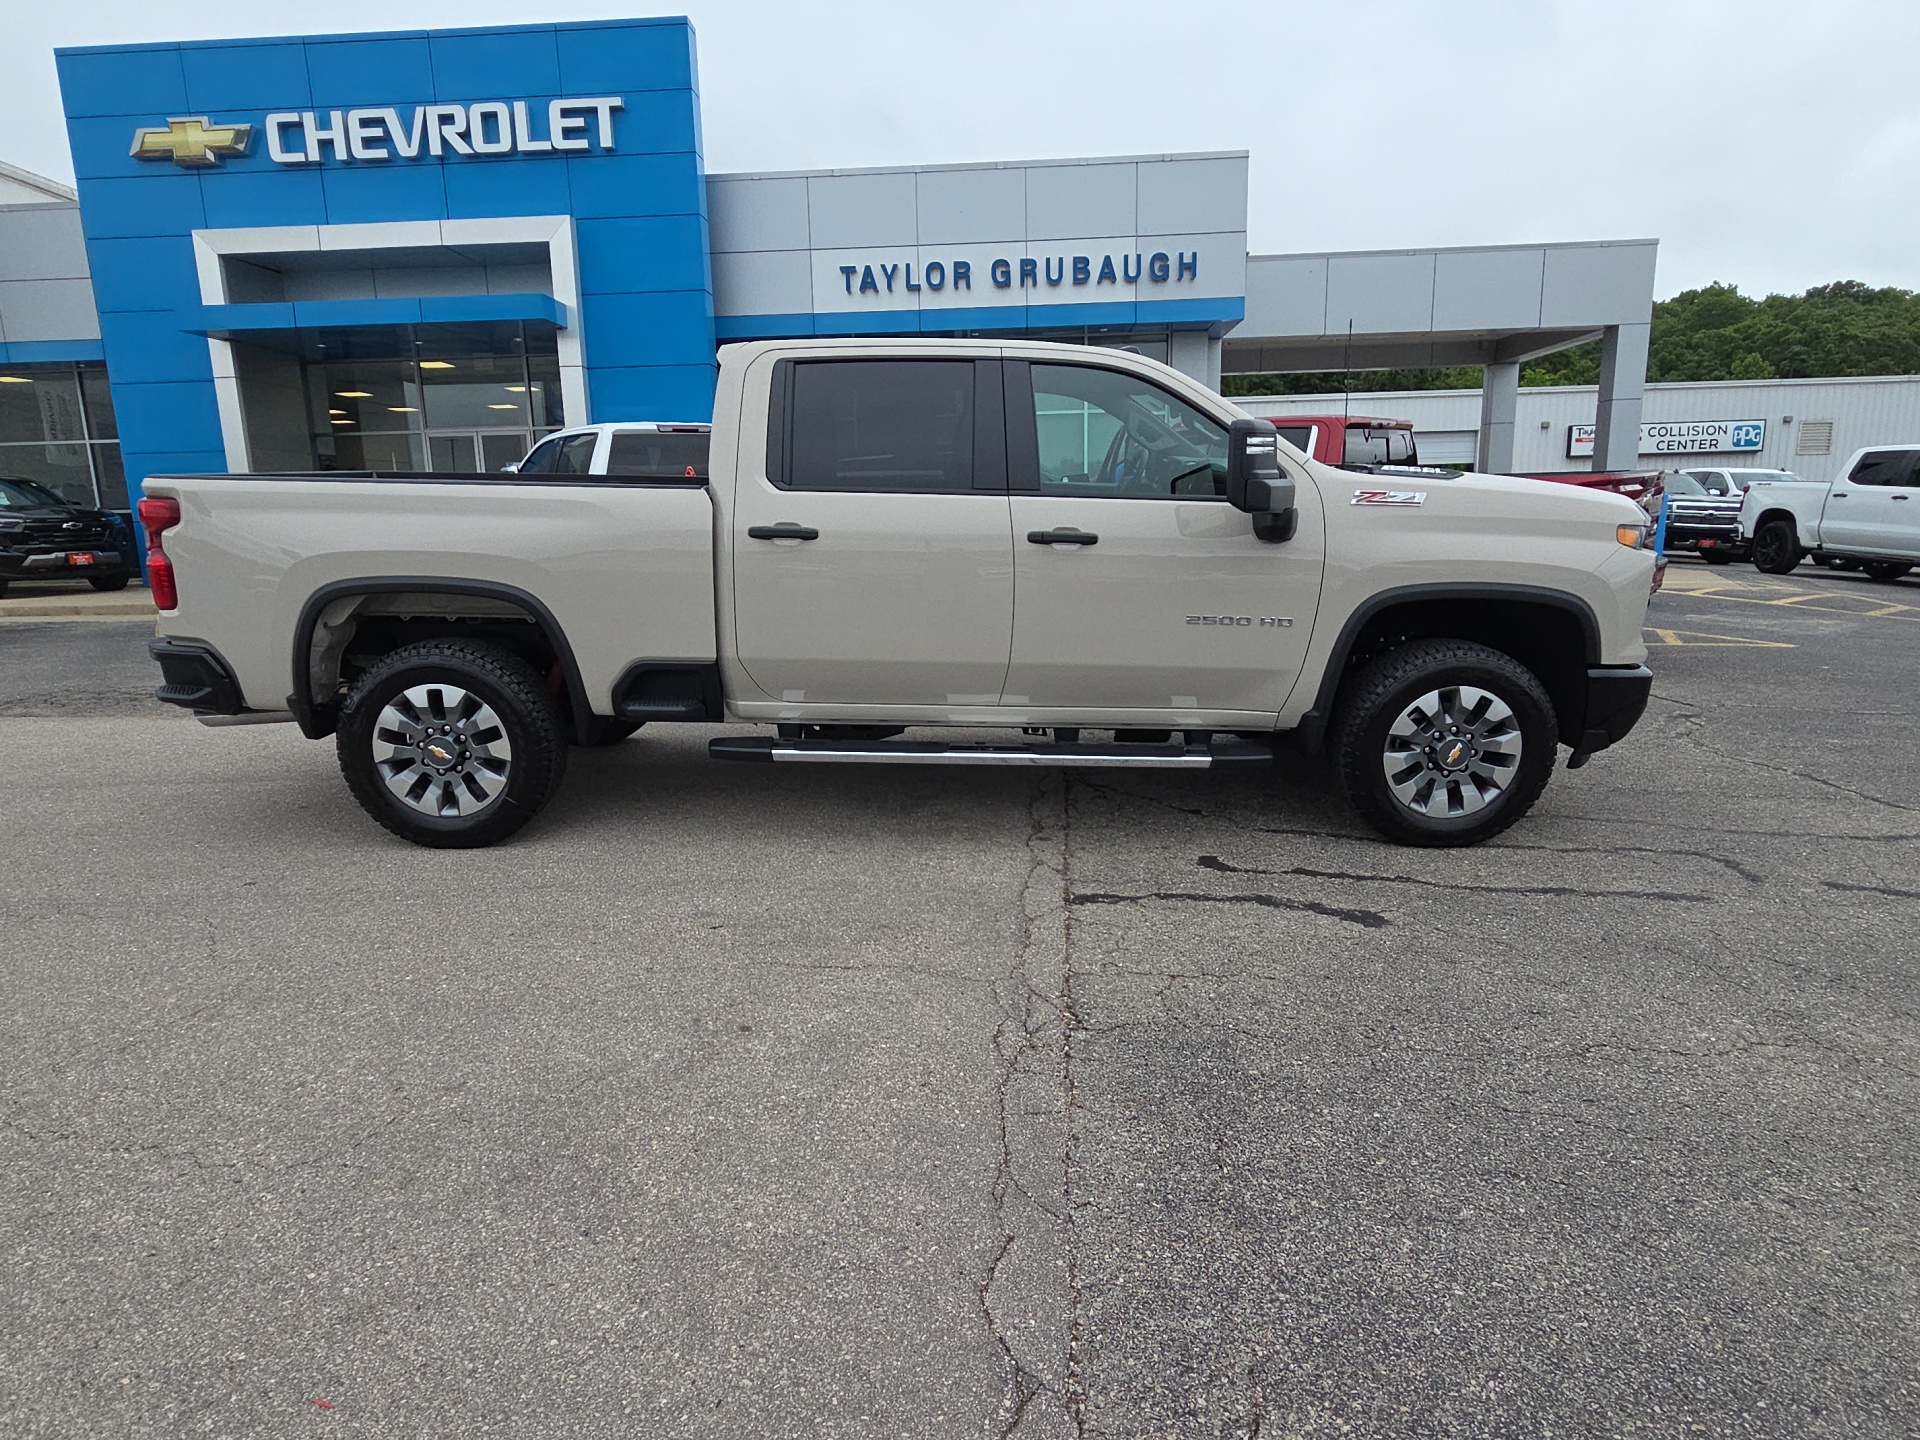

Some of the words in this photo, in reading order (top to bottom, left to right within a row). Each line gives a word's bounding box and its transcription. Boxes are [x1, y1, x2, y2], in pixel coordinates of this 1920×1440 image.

[265, 96, 624, 164] CHEVROLET
[839, 260, 972, 295] TAYLOR
[990, 251, 1199, 288] GRUBAUGH
[1647, 424, 1728, 438] COLLISION
[1733, 426, 1762, 446] PPG
[1656, 439, 1719, 451] CENTER
[1350, 489, 1427, 507] Z71
[1185, 614, 1252, 627] 2500
[1259, 616, 1294, 628] HD
